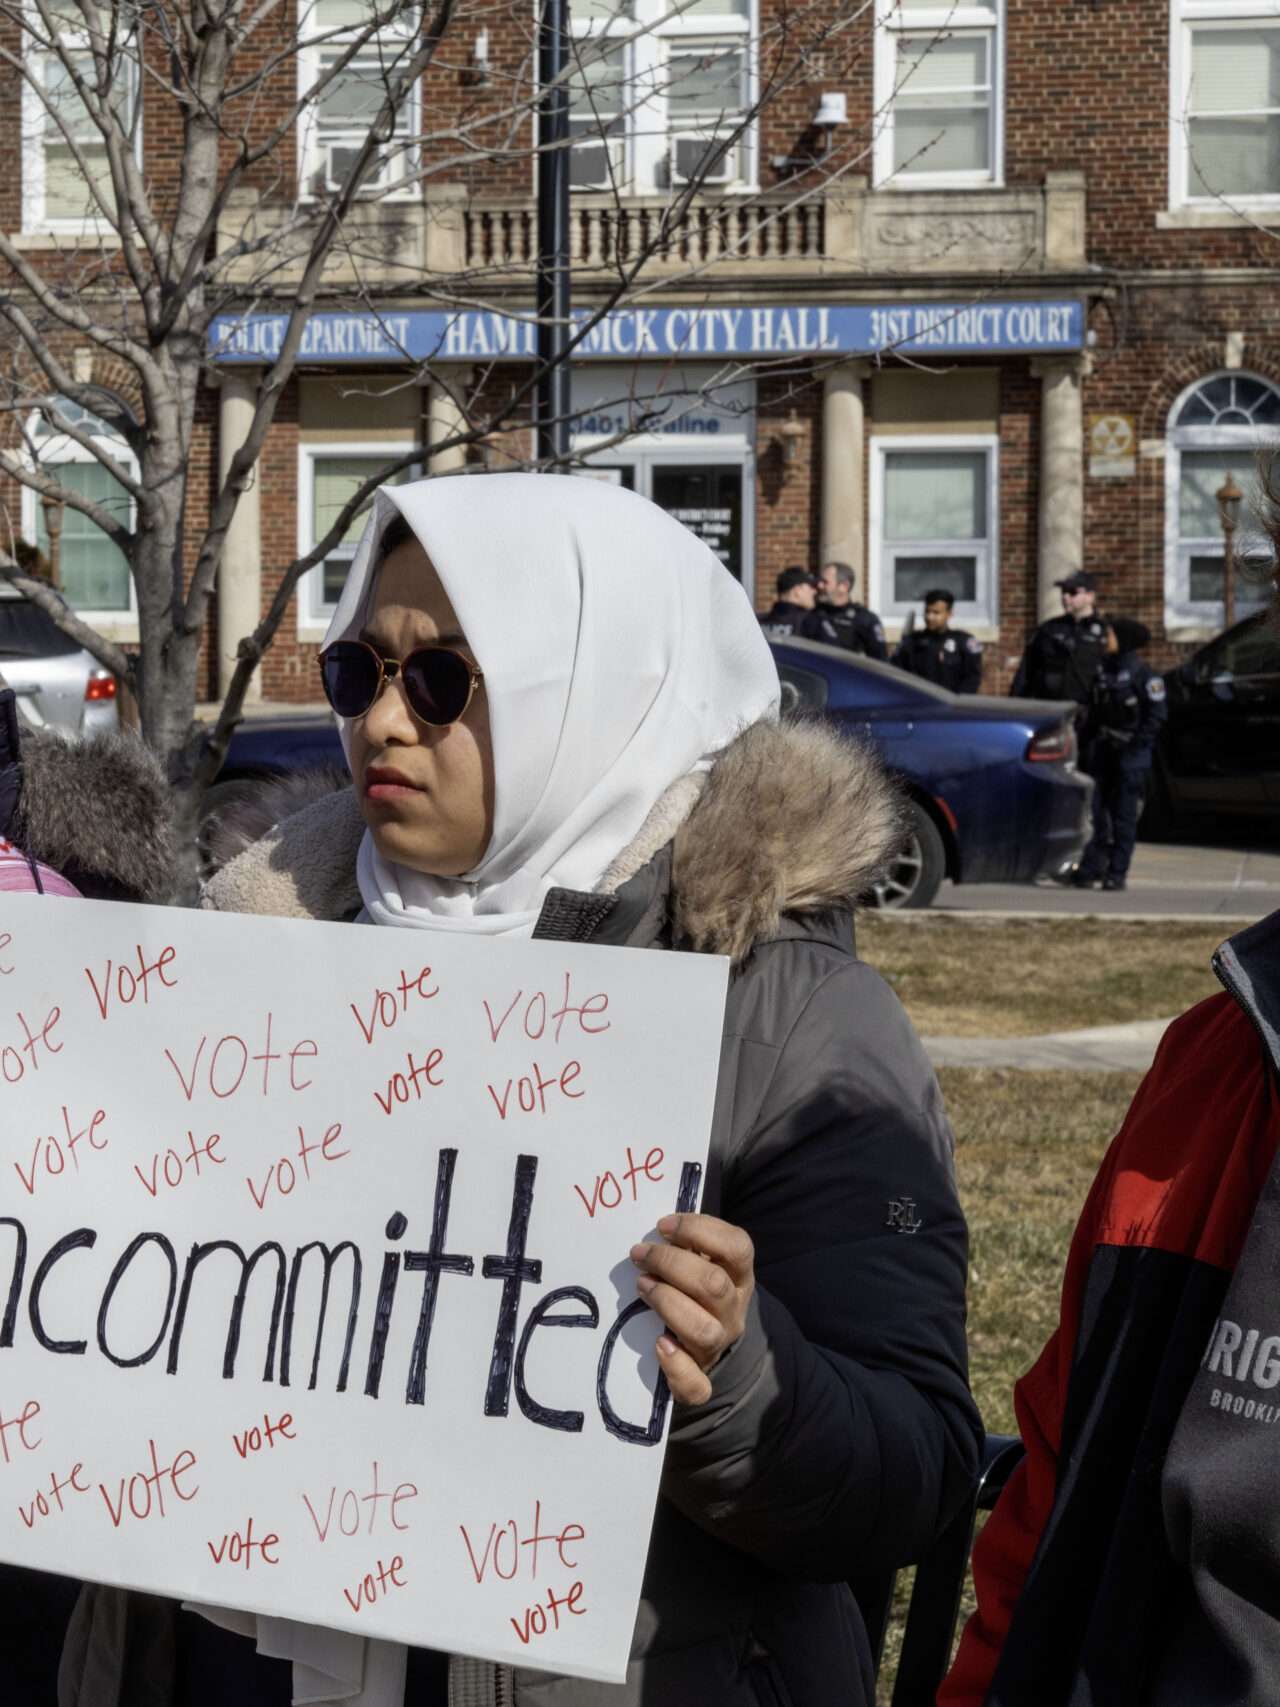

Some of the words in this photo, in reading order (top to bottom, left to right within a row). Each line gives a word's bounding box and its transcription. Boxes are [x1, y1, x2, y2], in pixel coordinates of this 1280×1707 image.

[299, 318, 409, 352] EPARTMENT
[665, 308, 742, 351] CITY
[751, 307, 839, 350] HALL
[870, 309, 912, 346] 31ST
[915, 308, 1002, 344] DISTRICT
[1006, 306, 1073, 342] COURT
[84, 944, 178, 1020] vote
[351, 966, 439, 1044] vote
[483, 972, 611, 1043] vote
[165, 1012, 319, 1101] vote
[373, 1048, 444, 1116] vote
[487, 1060, 585, 1120] vote
[15, 1105, 108, 1194] vote
[135, 1131, 226, 1197] vote
[248, 1123, 352, 1215] vote
[573, 1146, 666, 1219] vote
[1199, 1319, 1280, 1390] RIG
[231, 1412, 297, 1459] vote
[19, 1462, 91, 1529] vote
[100, 1439, 200, 1528] vote
[302, 1461, 418, 1543] vote
[207, 1517, 280, 1571] vote
[460, 1500, 586, 1584] vote
[343, 1555, 408, 1613] vote
[510, 1580, 587, 1645] vote
